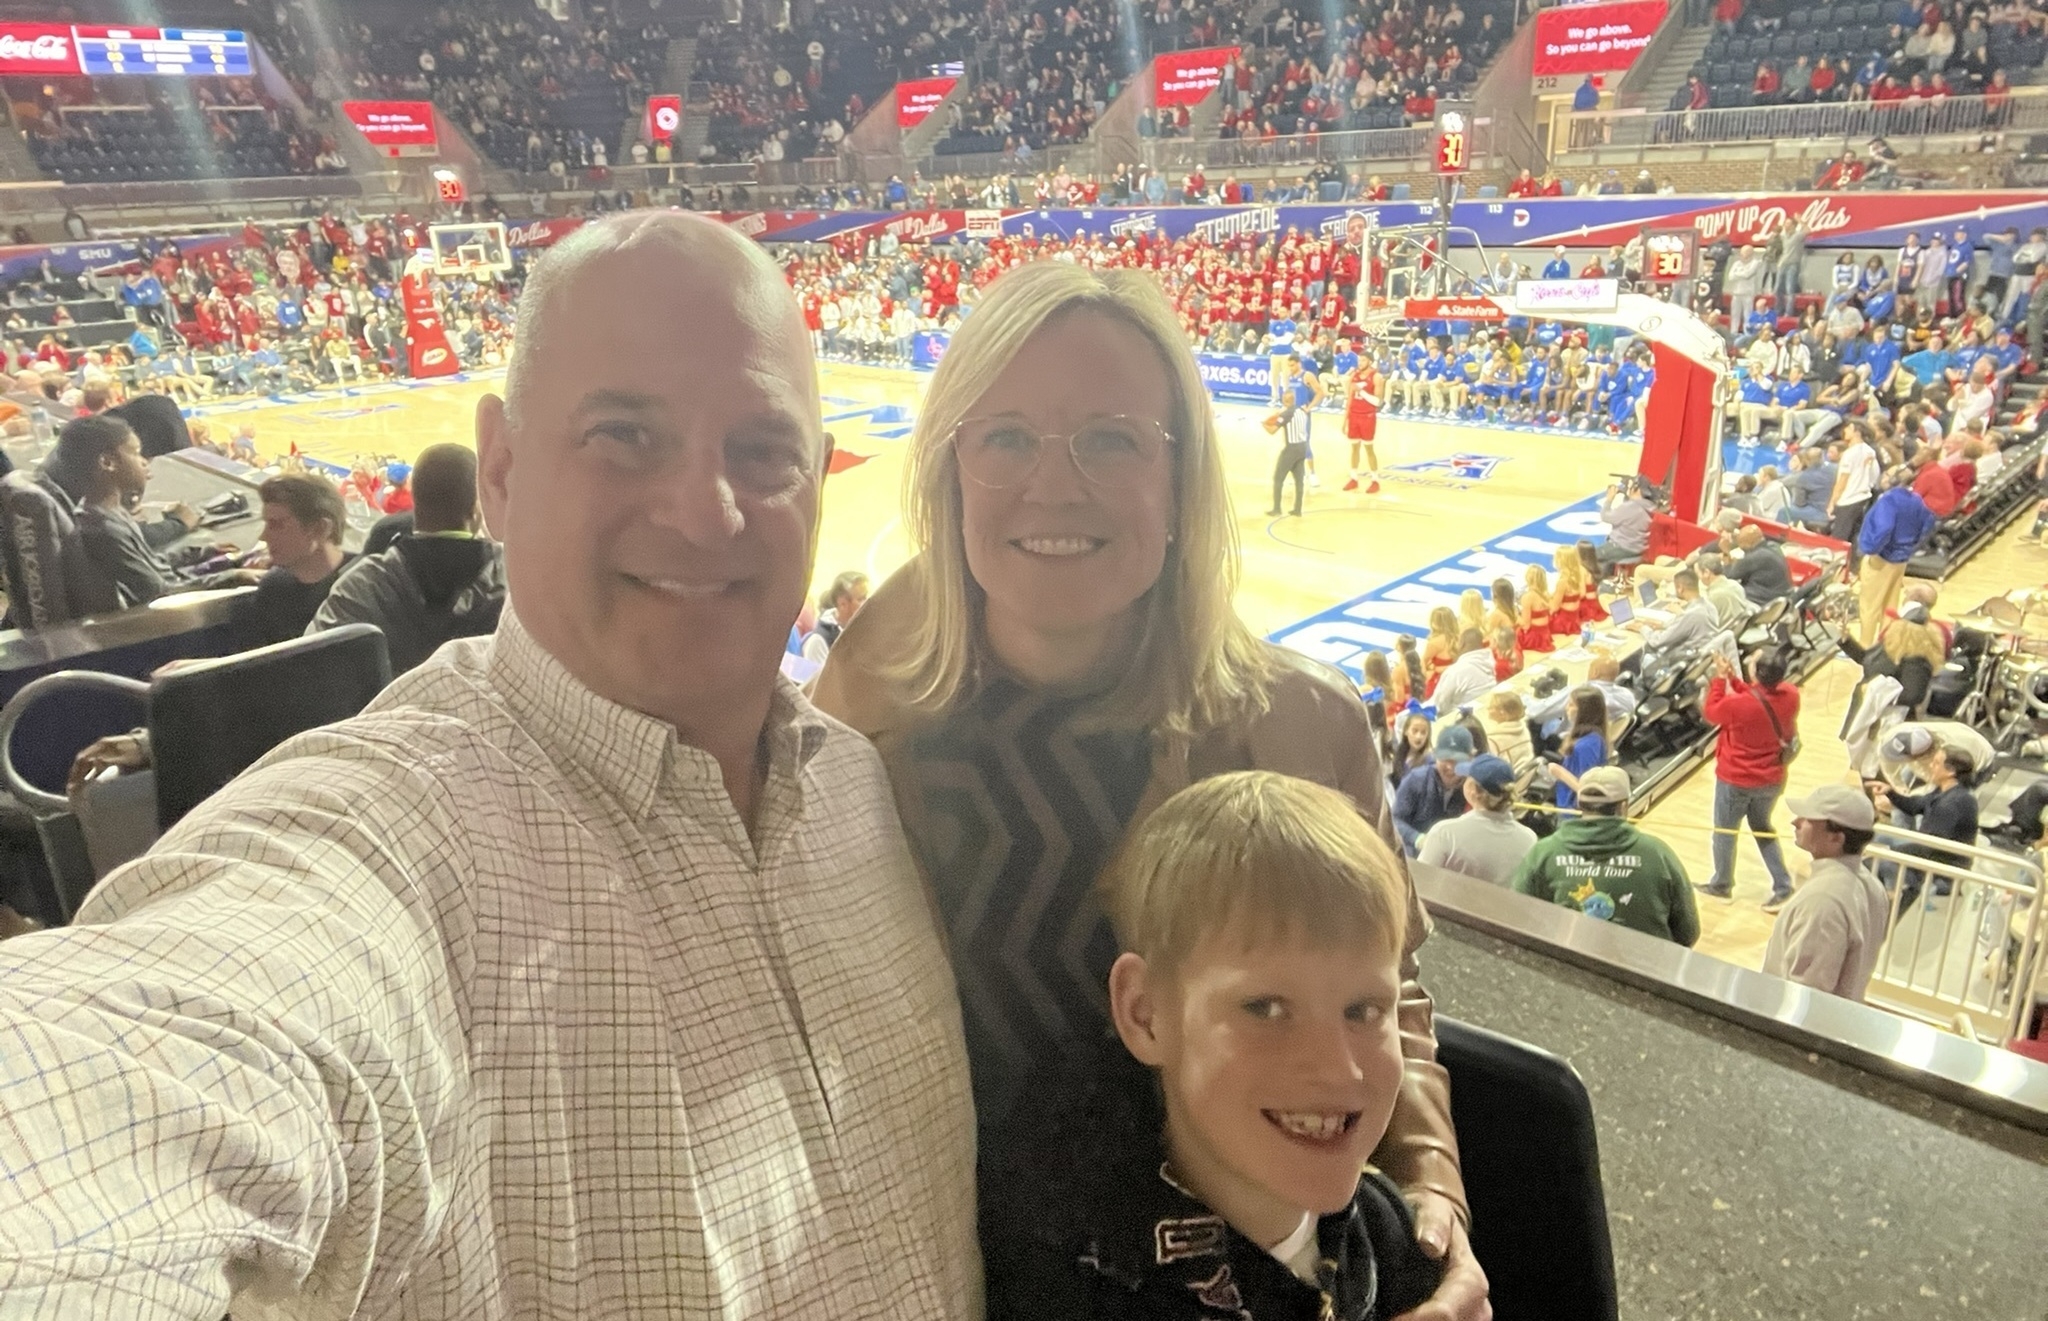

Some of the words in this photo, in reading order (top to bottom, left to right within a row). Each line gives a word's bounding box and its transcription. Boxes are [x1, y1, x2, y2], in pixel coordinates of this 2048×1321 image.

[1567, 27, 1584, 39] We
[1585, 27, 1598, 40] go
[1599, 24, 1632, 37] above.
[1546, 43, 1559, 55] So
[1560, 43, 1578, 56] you
[1579, 41, 1598, 52] can
[1599, 41, 1613, 53] go
[1537, 77, 1557, 89] 212
[1442, 133, 1463, 167] 30
[440, 181, 460, 198] 30
[1420, 206, 1433, 215] 112
[1488, 204, 1503, 213] 113
[1737, 205, 1760, 233] UP
[508, 221, 552, 246] Dallas
[79, 248, 112, 260] SMU
[1658, 252, 1682, 275] 30
[1200, 365, 1272, 386] axes.co
[1566, 865, 1600, 877] World
[1604, 866, 1634, 877] Tour
